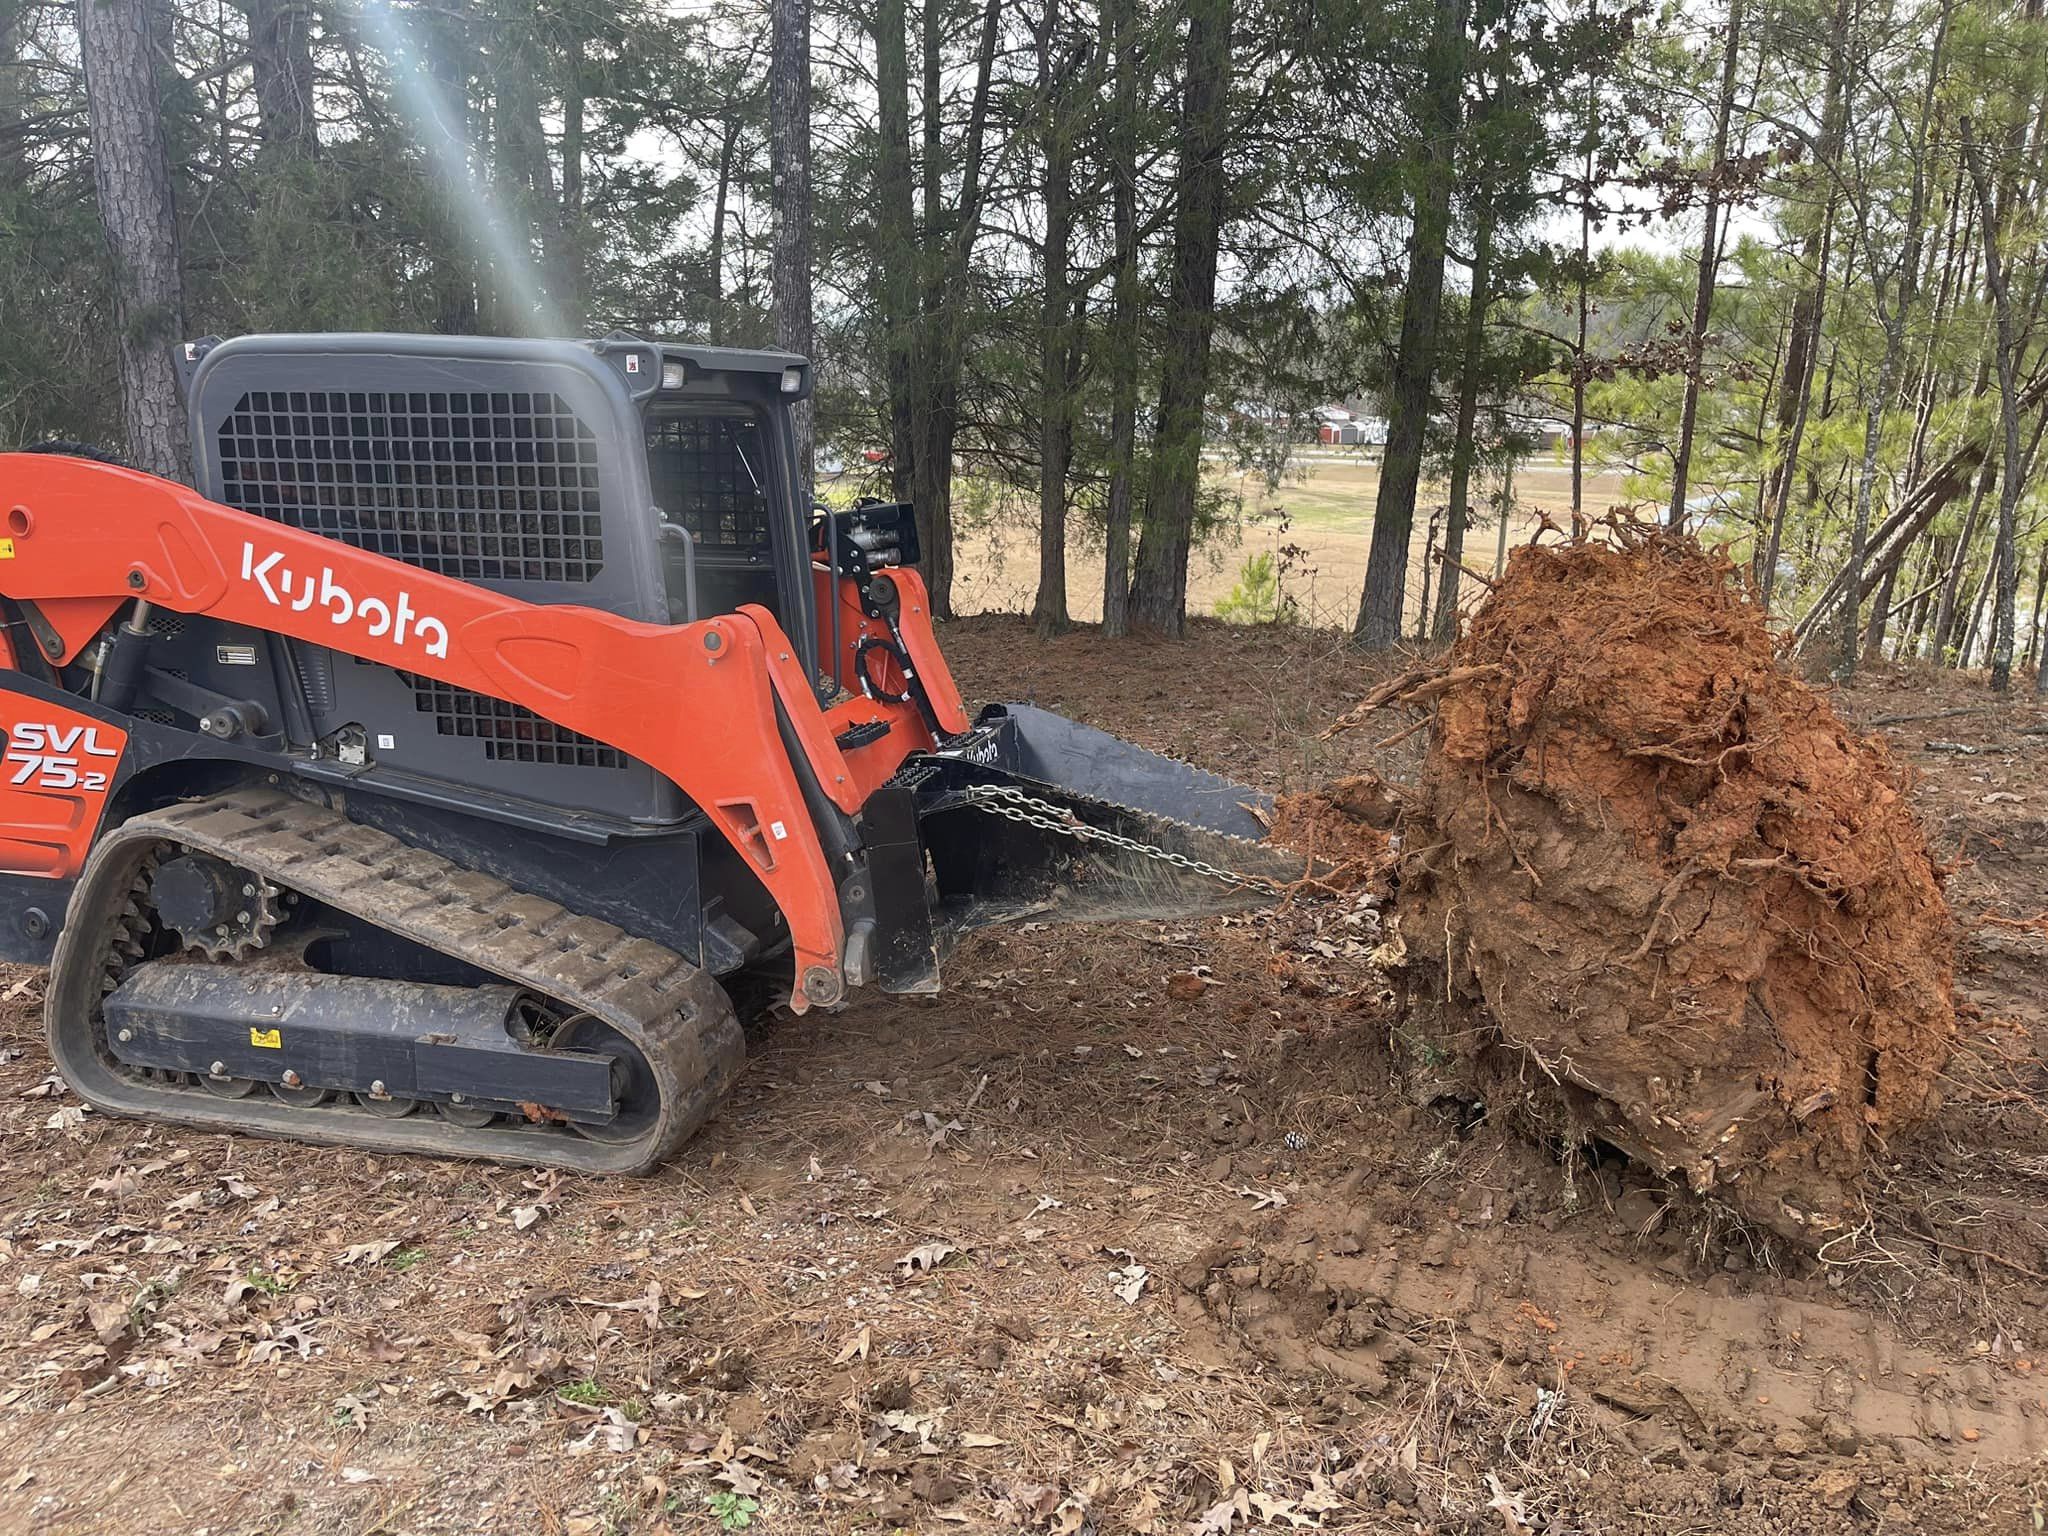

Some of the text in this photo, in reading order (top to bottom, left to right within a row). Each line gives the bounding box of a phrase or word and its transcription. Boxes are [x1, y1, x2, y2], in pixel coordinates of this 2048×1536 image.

[241, 541, 449, 660] Kubota
[10, 722, 117, 757] SVL
[7, 752, 107, 791] 75-2
